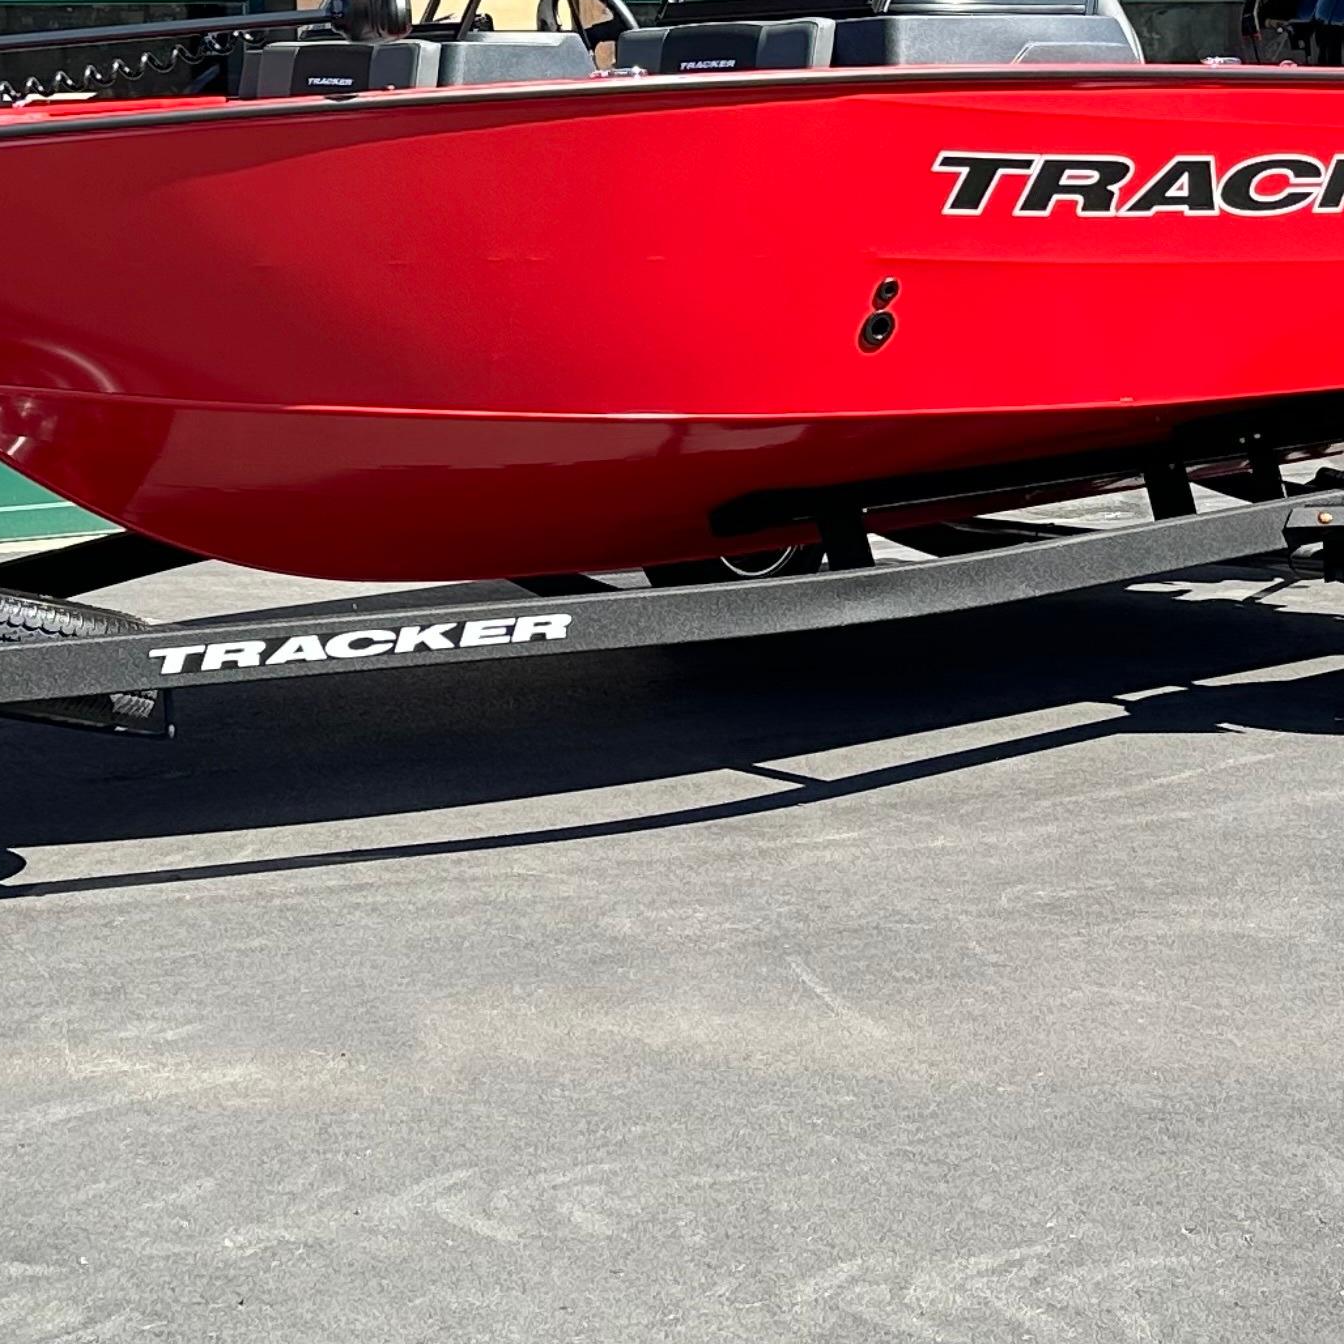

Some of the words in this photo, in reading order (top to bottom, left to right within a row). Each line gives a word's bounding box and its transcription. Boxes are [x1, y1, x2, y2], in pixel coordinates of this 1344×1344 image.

[679, 59, 736, 70] TRACKER
[308, 77, 354, 86] TRACKER
[148, 613, 573, 674] TRACKER
